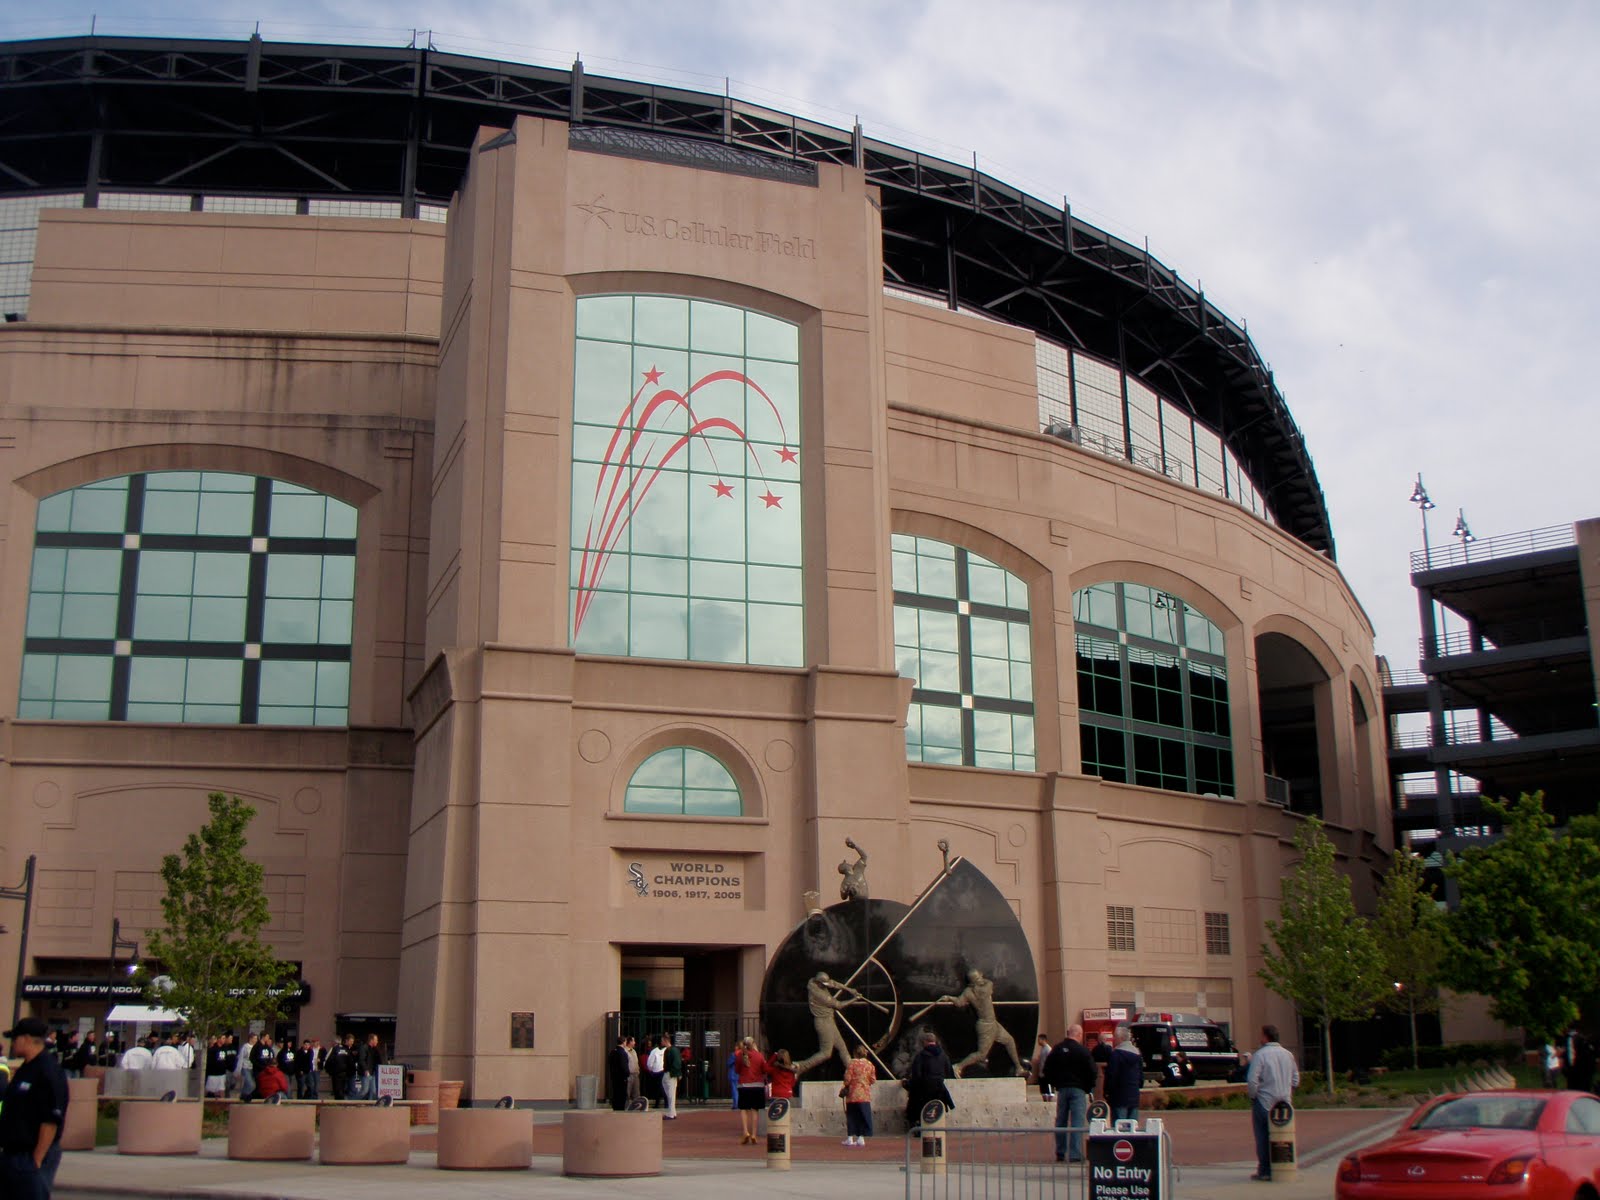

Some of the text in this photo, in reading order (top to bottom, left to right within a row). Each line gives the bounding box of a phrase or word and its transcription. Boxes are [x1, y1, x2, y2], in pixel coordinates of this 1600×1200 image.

[619, 211, 816, 259] U.S. Cellular Field
[670, 863, 725, 873] WORLD
[654, 876, 740, 886] CHAMPIONS
[653, 890, 682, 898] 1906,
[685, 891, 711, 899] 1917,
[772, 1103, 783, 1116] 3
[926, 1105, 938, 1118] 4
[1092, 1106, 1103, 1119] 9
[1273, 1107, 1288, 1120] 11
[1094, 1166, 1152, 1182] No Entry
[1095, 1185, 1149, 1195] Please Use
